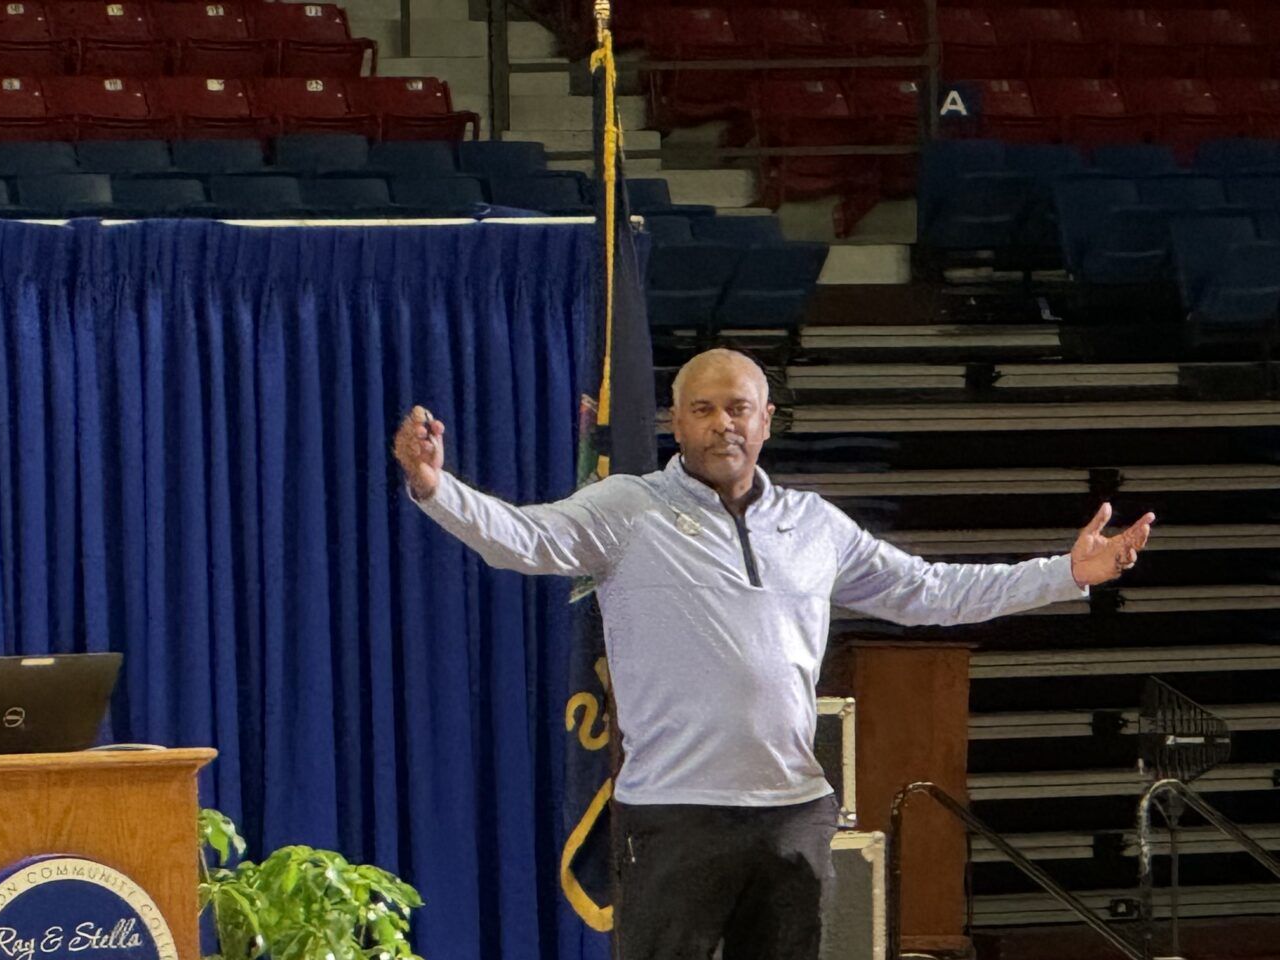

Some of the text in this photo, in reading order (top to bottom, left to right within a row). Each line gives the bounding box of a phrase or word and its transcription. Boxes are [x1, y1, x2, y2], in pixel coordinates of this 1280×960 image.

[940, 90, 968, 115] A
[26, 865, 137, 898] COMMUNITY
[40, 925, 64, 953] &
[68, 917, 142, 952] Stella
